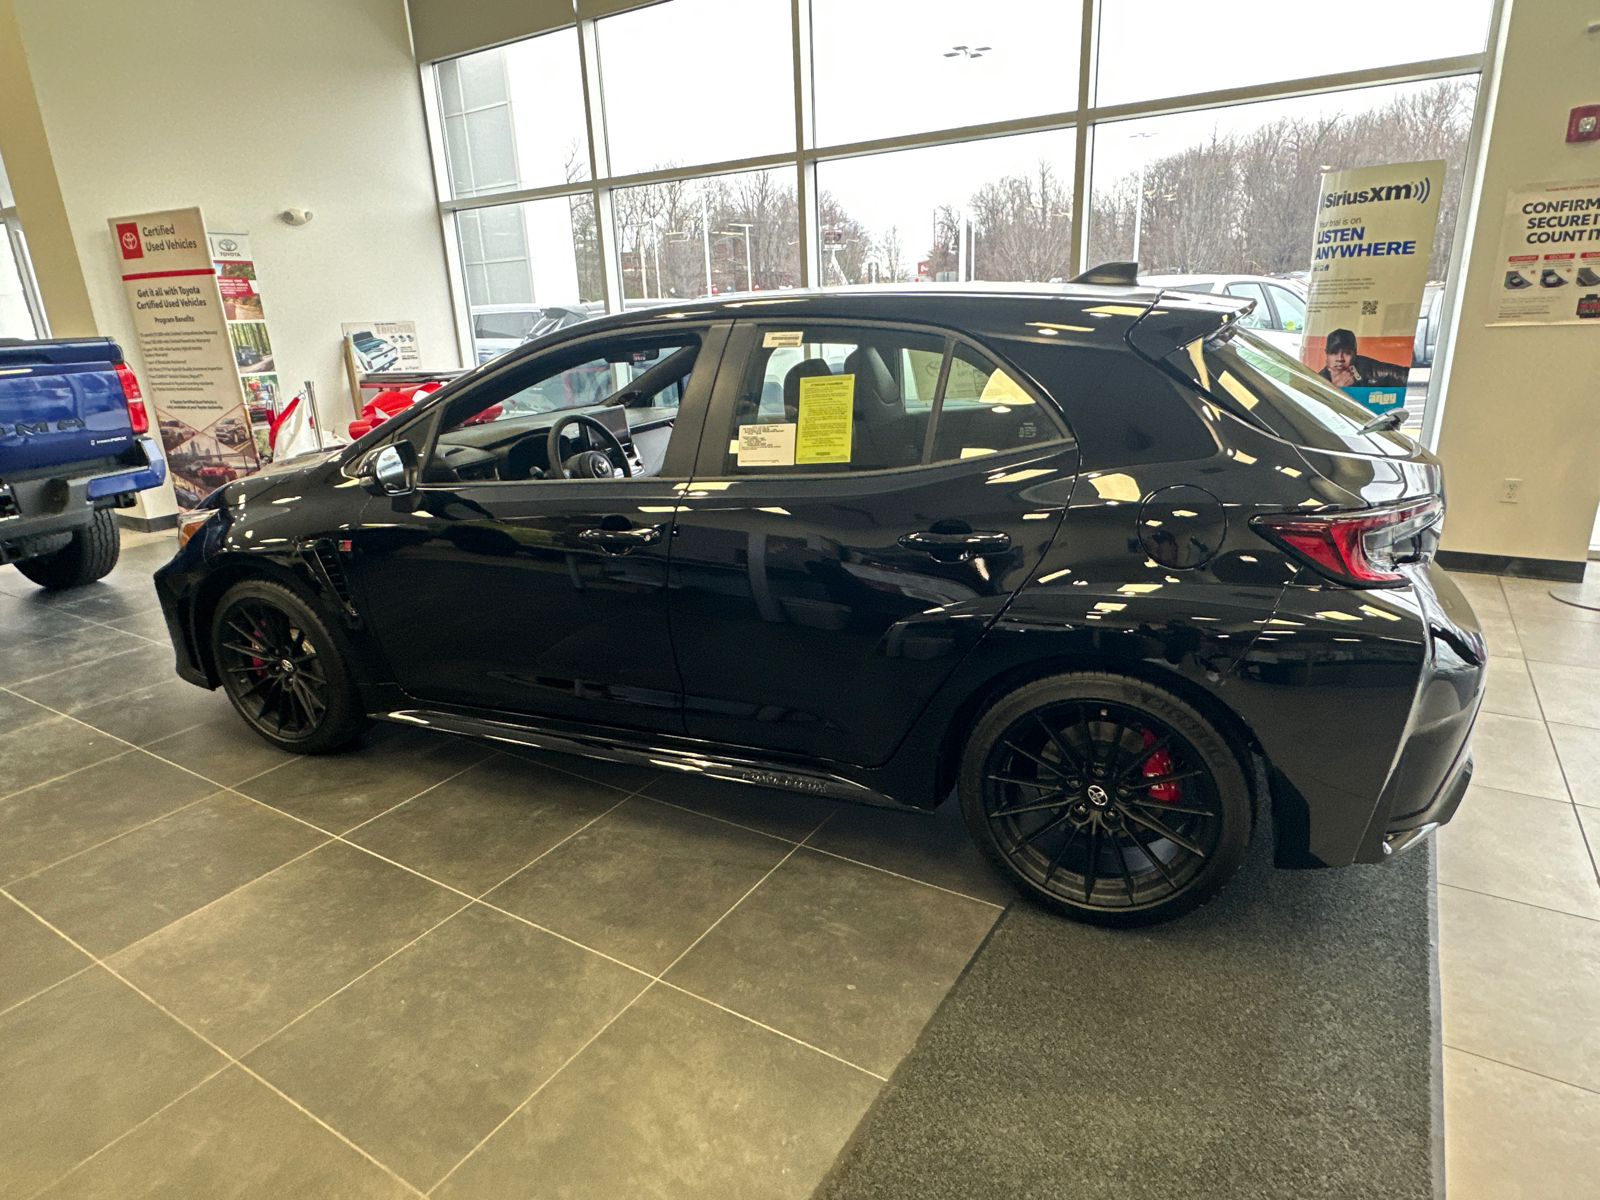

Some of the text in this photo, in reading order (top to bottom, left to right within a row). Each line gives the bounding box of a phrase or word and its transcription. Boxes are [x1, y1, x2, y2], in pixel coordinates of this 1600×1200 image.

[1522, 197, 1600, 214] CONFIRM
[1350, 217, 1361, 225] on
[1526, 213, 1600, 229] SECURE I
[142, 224, 175, 237] Certified
[1317, 226, 1365, 244] LISTEN
[1526, 229, 1586, 244] COUNT
[146, 239, 197, 252] Used Vehicles
[1315, 240, 1416, 260] ANYWHERE
[137, 285, 200, 298] Get it all with Toyota
[136, 298, 206, 309] Certified Used Vehicles
[154, 315, 195, 324] Program Benefits
[0, 418, 84, 436] MA
